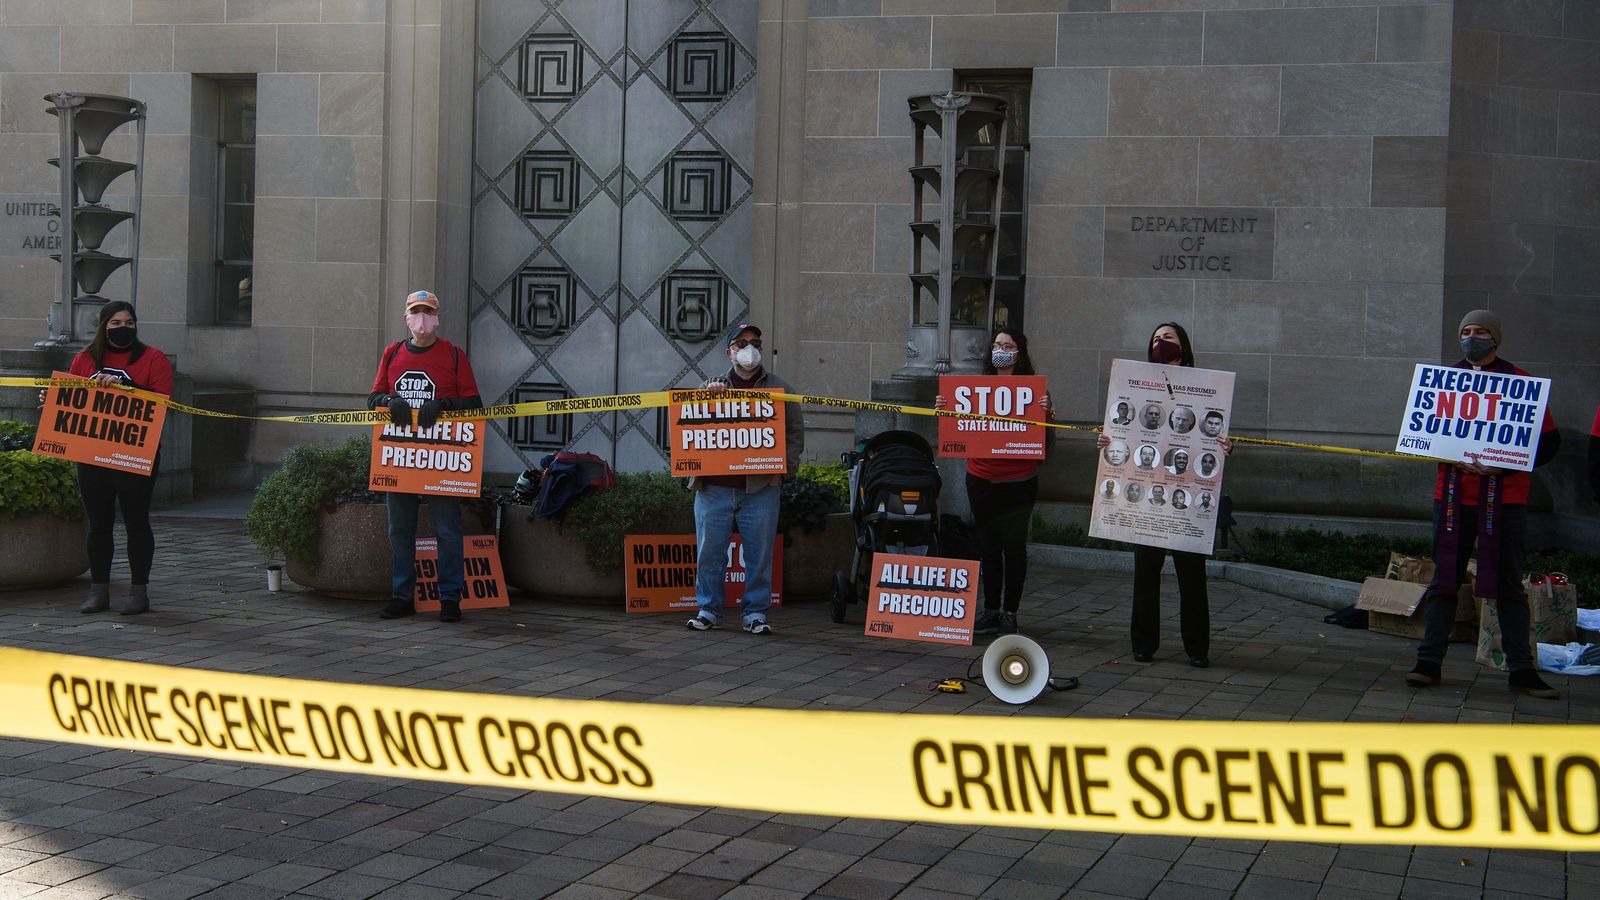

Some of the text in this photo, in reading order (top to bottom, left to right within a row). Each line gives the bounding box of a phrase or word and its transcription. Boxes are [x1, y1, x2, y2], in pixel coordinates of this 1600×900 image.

[5, 202, 57, 216] UNITED
[47, 220, 58, 233] O
[1131, 216, 1258, 234] DEPARTMENT
[1180, 236, 1206, 251] OF
[1152, 255, 1232, 272] JUSTICE
[400, 378, 428, 390] STOP
[1141, 380, 1166, 388] KILLING
[1187, 386, 1217, 395] RESUMED
[1419, 367, 1542, 402] EXECUTION
[546, 395, 641, 411] CRIME SCENE DO NOT CROSS
[672, 389, 770, 402] CRIME SCENE DO NOT CROSS
[802, 396, 826, 405] CRIME
[826, 398, 849, 408] SCENE
[954, 386, 1033, 416] STOP
[56, 387, 89, 410] NO
[92, 390, 156, 423] MORE
[493, 405, 516, 415] CROSS
[681, 399, 775, 419] ALL LIFE IS
[1414, 390, 1537, 424] IS NOT THE
[317, 414, 340, 423] SCENE
[341, 413, 351, 423] DO
[352, 412, 367, 422] NOT
[367, 411, 391, 421] CROSS
[957, 419, 987, 432] STATE
[988, 420, 1027, 432] KILLING
[54, 410, 148, 447] KILLING!
[455, 421, 475, 442] IS
[1409, 411, 1533, 447] SOLUTION
[682, 427, 775, 450] PRECIOUS
[1400, 437, 1431, 450] ACTION
[381, 445, 472, 472] PRECIOUS
[675, 461, 702, 471] ACTION
[372, 476, 398, 487] ACTION
[633, 543, 654, 564] NO
[881, 563, 968, 589] ALL LIFE IS
[473, 578, 499, 599] NO
[879, 592, 965, 619] PRECIOUS
[869, 623, 893, 633] ACTION
[49, 671, 654, 789] CRIME SCENE DO NOT CROSS
[911, 739, 1600, 836] CRIME SCENE DO NO
